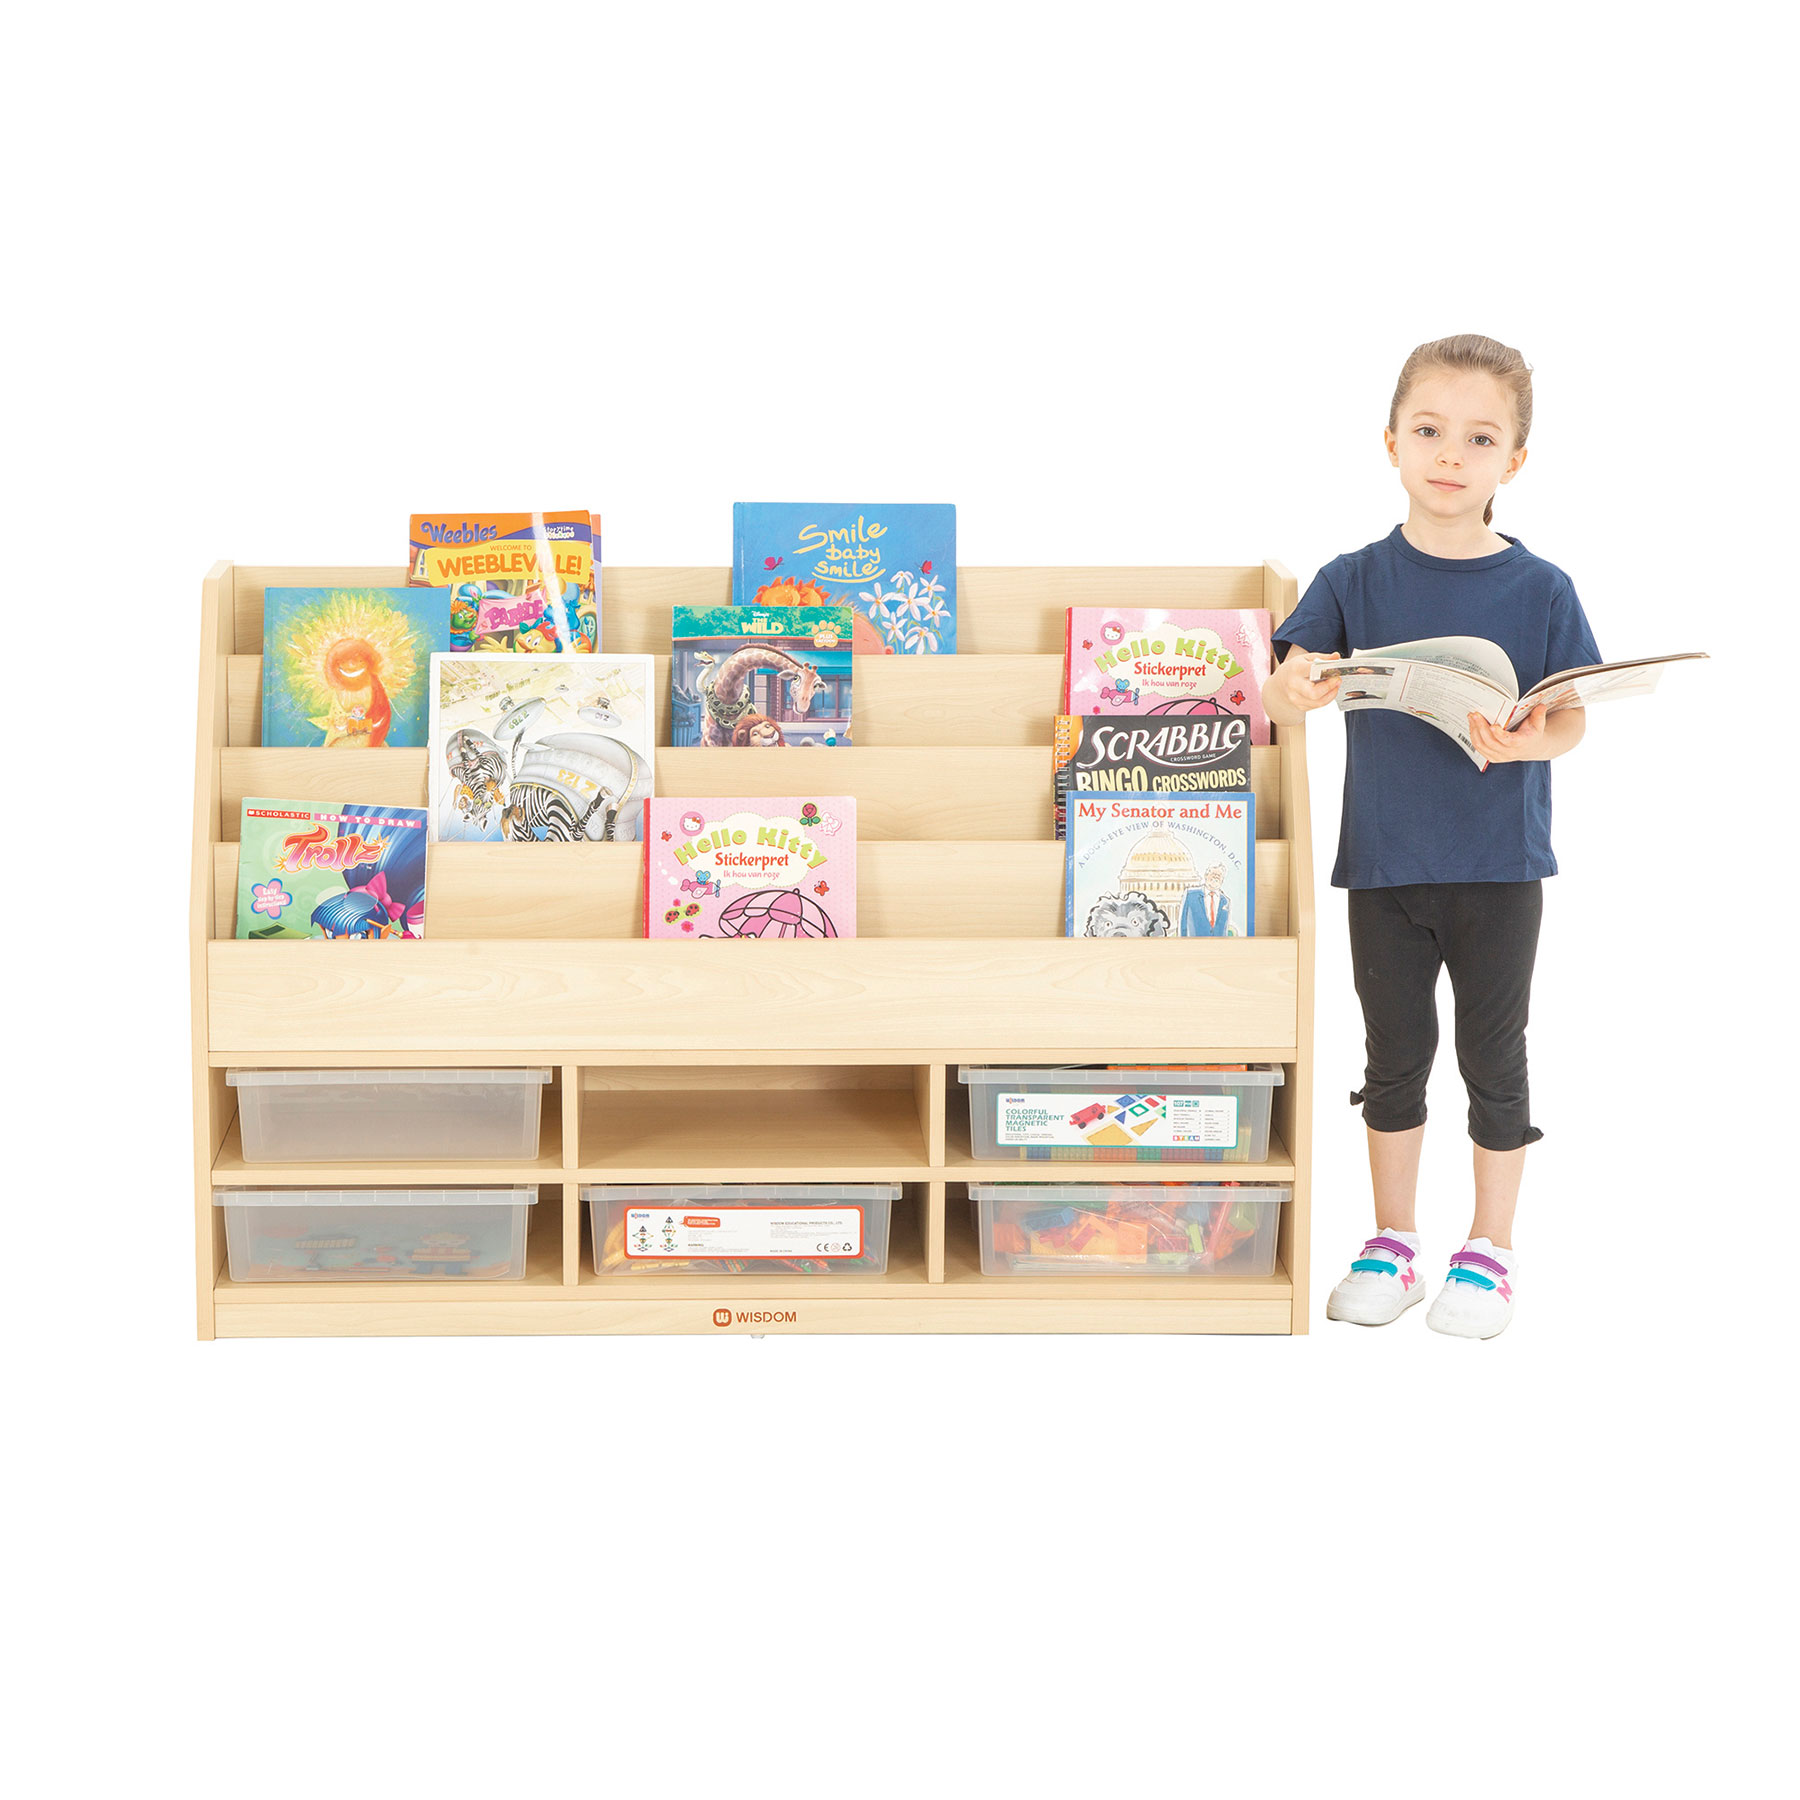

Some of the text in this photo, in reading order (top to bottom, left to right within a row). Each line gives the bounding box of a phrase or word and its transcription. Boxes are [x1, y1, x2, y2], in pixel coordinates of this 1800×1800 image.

[420, 522, 497, 543] Weebles
[793, 515, 888, 554] Smile
[825, 543, 880, 564] baby
[437, 553, 582, 578] WEEBLEVLE!
[741, 622, 784, 634] WILD
[1093, 637, 1244, 680] Hello Kitty
[1134, 661, 1206, 681] Stickerpret
[1142, 679, 1197, 690] Ik hou van roze
[557, 769, 598, 799] Z 123
[1076, 765, 1247, 792] BINGO CROSSWORDS
[255, 811, 416, 828] SCHOLASTIC HOW TO DRAW
[1078, 803, 1242, 822] My Senator and Me
[1125, 821, 1149, 832] VIEW
[1152, 820, 1164, 828] OF
[283, 823, 382, 873] Trollz
[673, 827, 828, 869] Hello Kitty
[715, 852, 789, 871] Stickerpret
[723, 870, 731, 878] Ik
[732, 870, 746, 878] hou
[763, 871, 780, 880] roze
[736, 1311, 796, 1323] WISDOM
